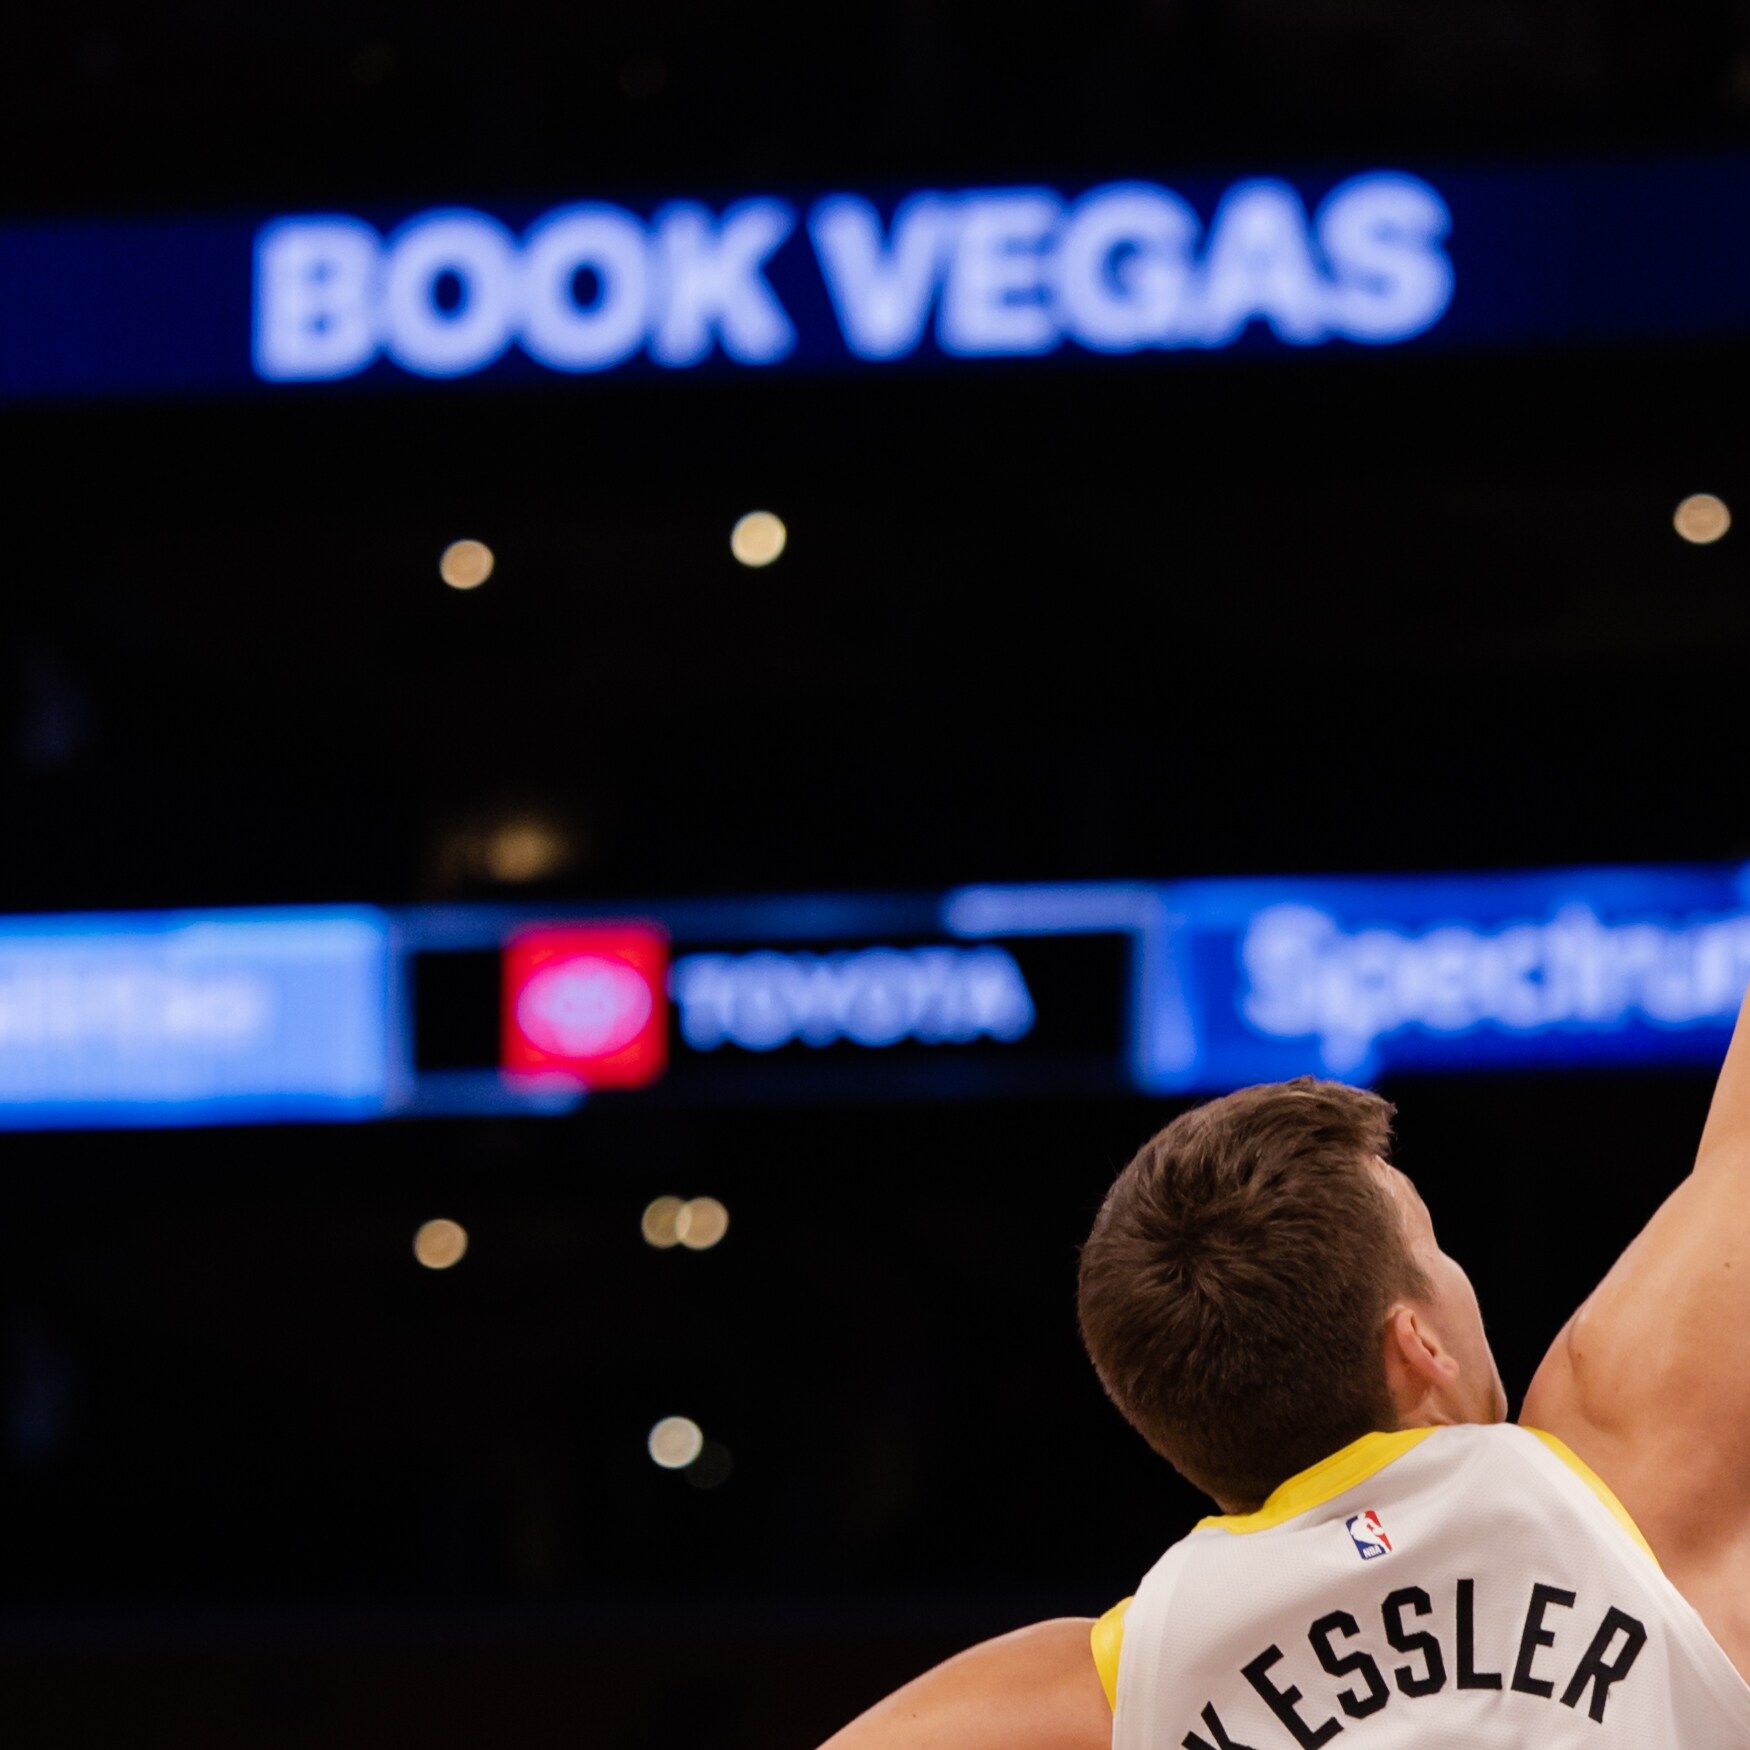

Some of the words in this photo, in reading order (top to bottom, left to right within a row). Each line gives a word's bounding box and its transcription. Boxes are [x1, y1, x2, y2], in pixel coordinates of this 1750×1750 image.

[252, 210, 796, 382] BOOK
[806, 168, 1456, 362] VEGAS
[668, 945, 1035, 1052] TOYOTA
